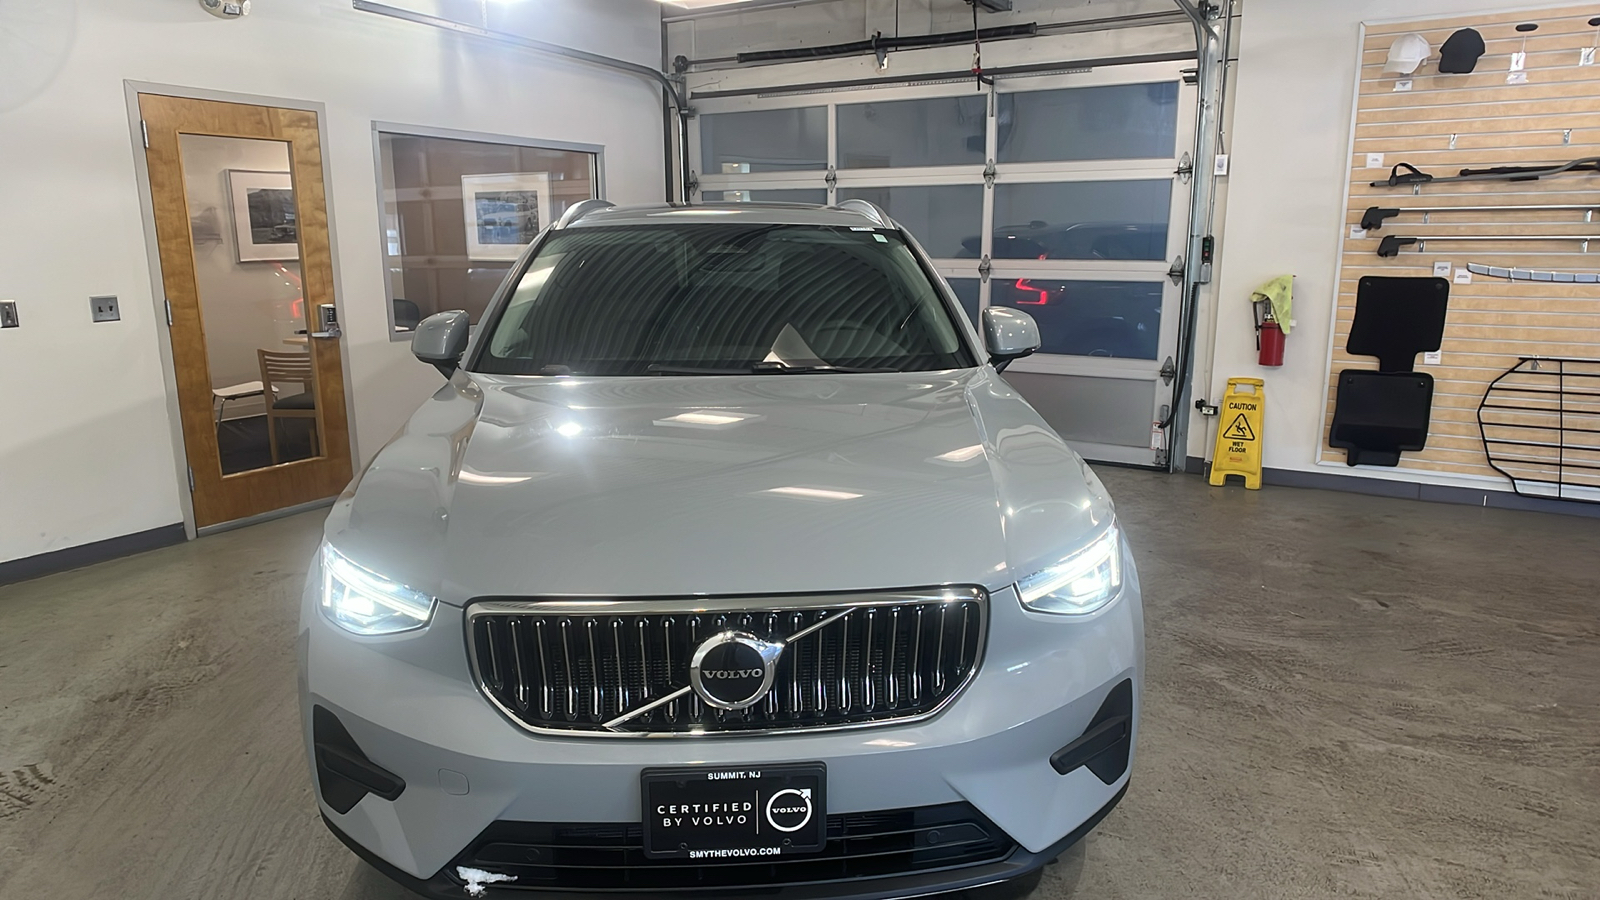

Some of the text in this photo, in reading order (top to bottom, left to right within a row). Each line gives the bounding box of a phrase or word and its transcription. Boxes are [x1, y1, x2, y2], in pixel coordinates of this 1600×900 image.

[1229, 402, 1256, 410] CAUTION
[702, 668, 763, 679] VOLVO
[707, 771, 747, 780] SUMMIT,
[656, 802, 752, 815] CERTIFIED
[772, 806, 807, 814] VOLVO
[663, 815, 747, 827] BY VOLVO
[689, 847, 781, 859] SMYTHEVOLVO.COM
